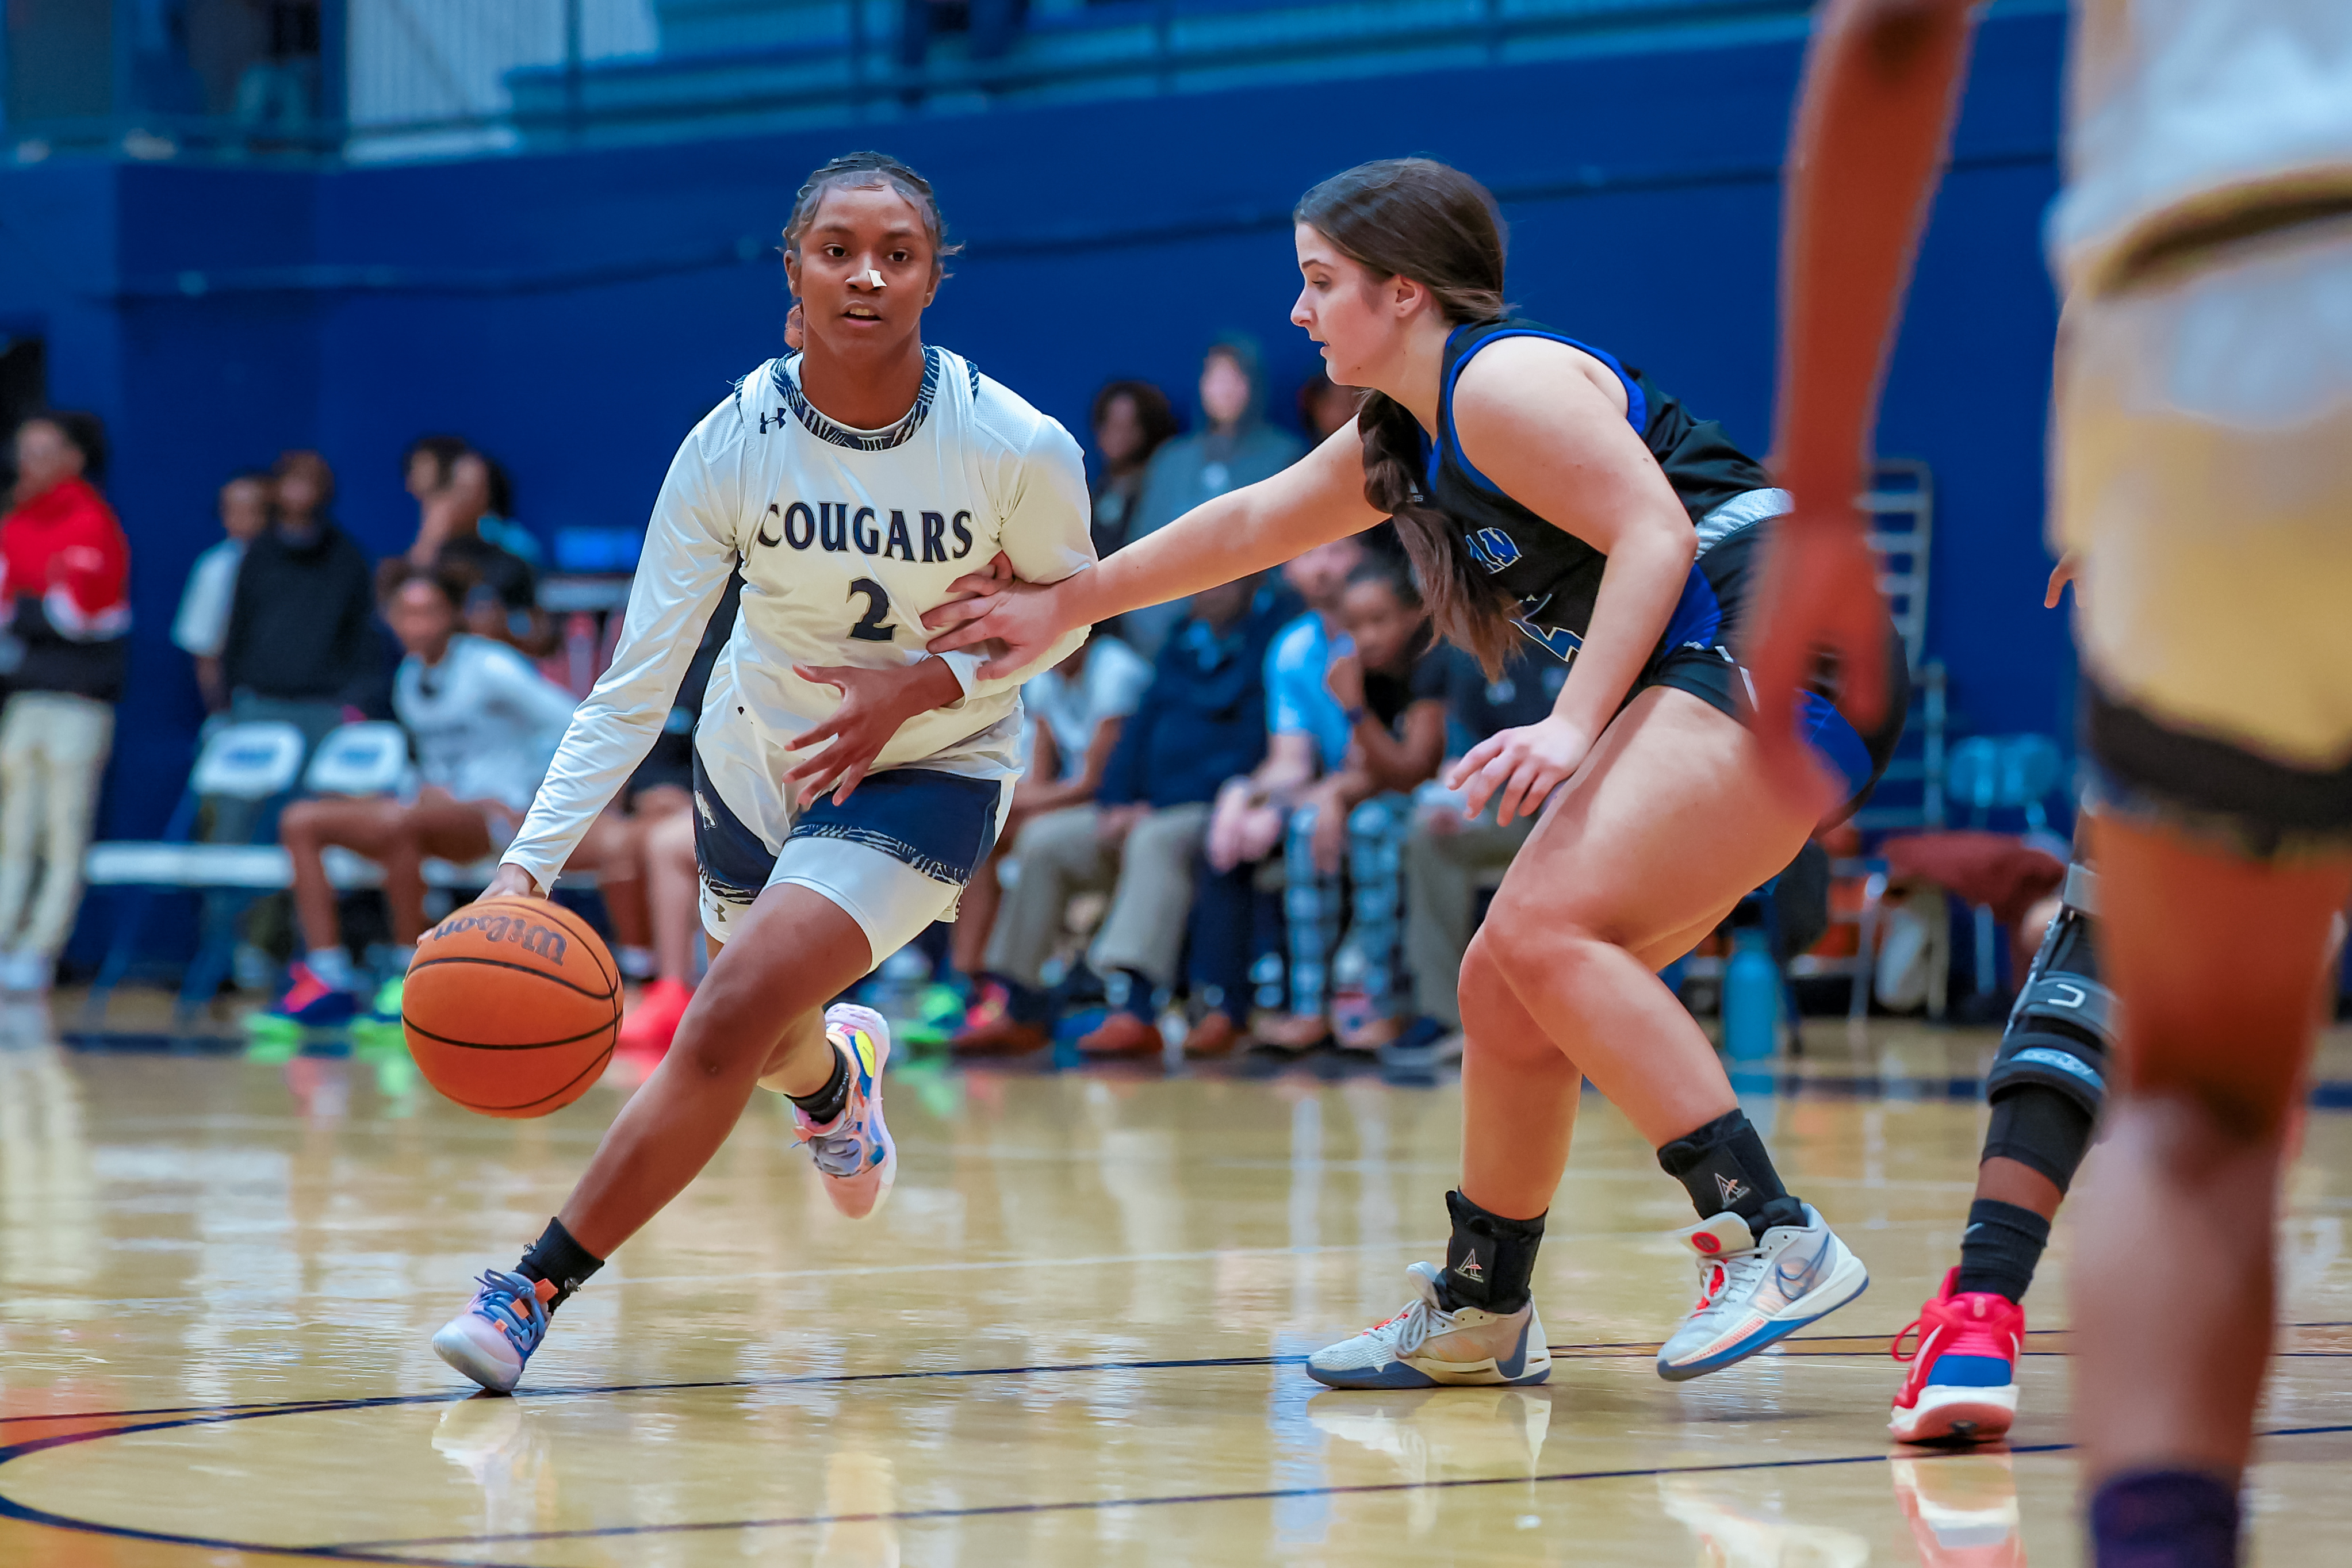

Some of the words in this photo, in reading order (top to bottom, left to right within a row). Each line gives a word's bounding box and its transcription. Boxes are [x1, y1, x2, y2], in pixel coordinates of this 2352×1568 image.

[757, 500, 973, 564] COUGARS
[846, 577, 898, 643] 2
[433, 915, 568, 967] Wilson
